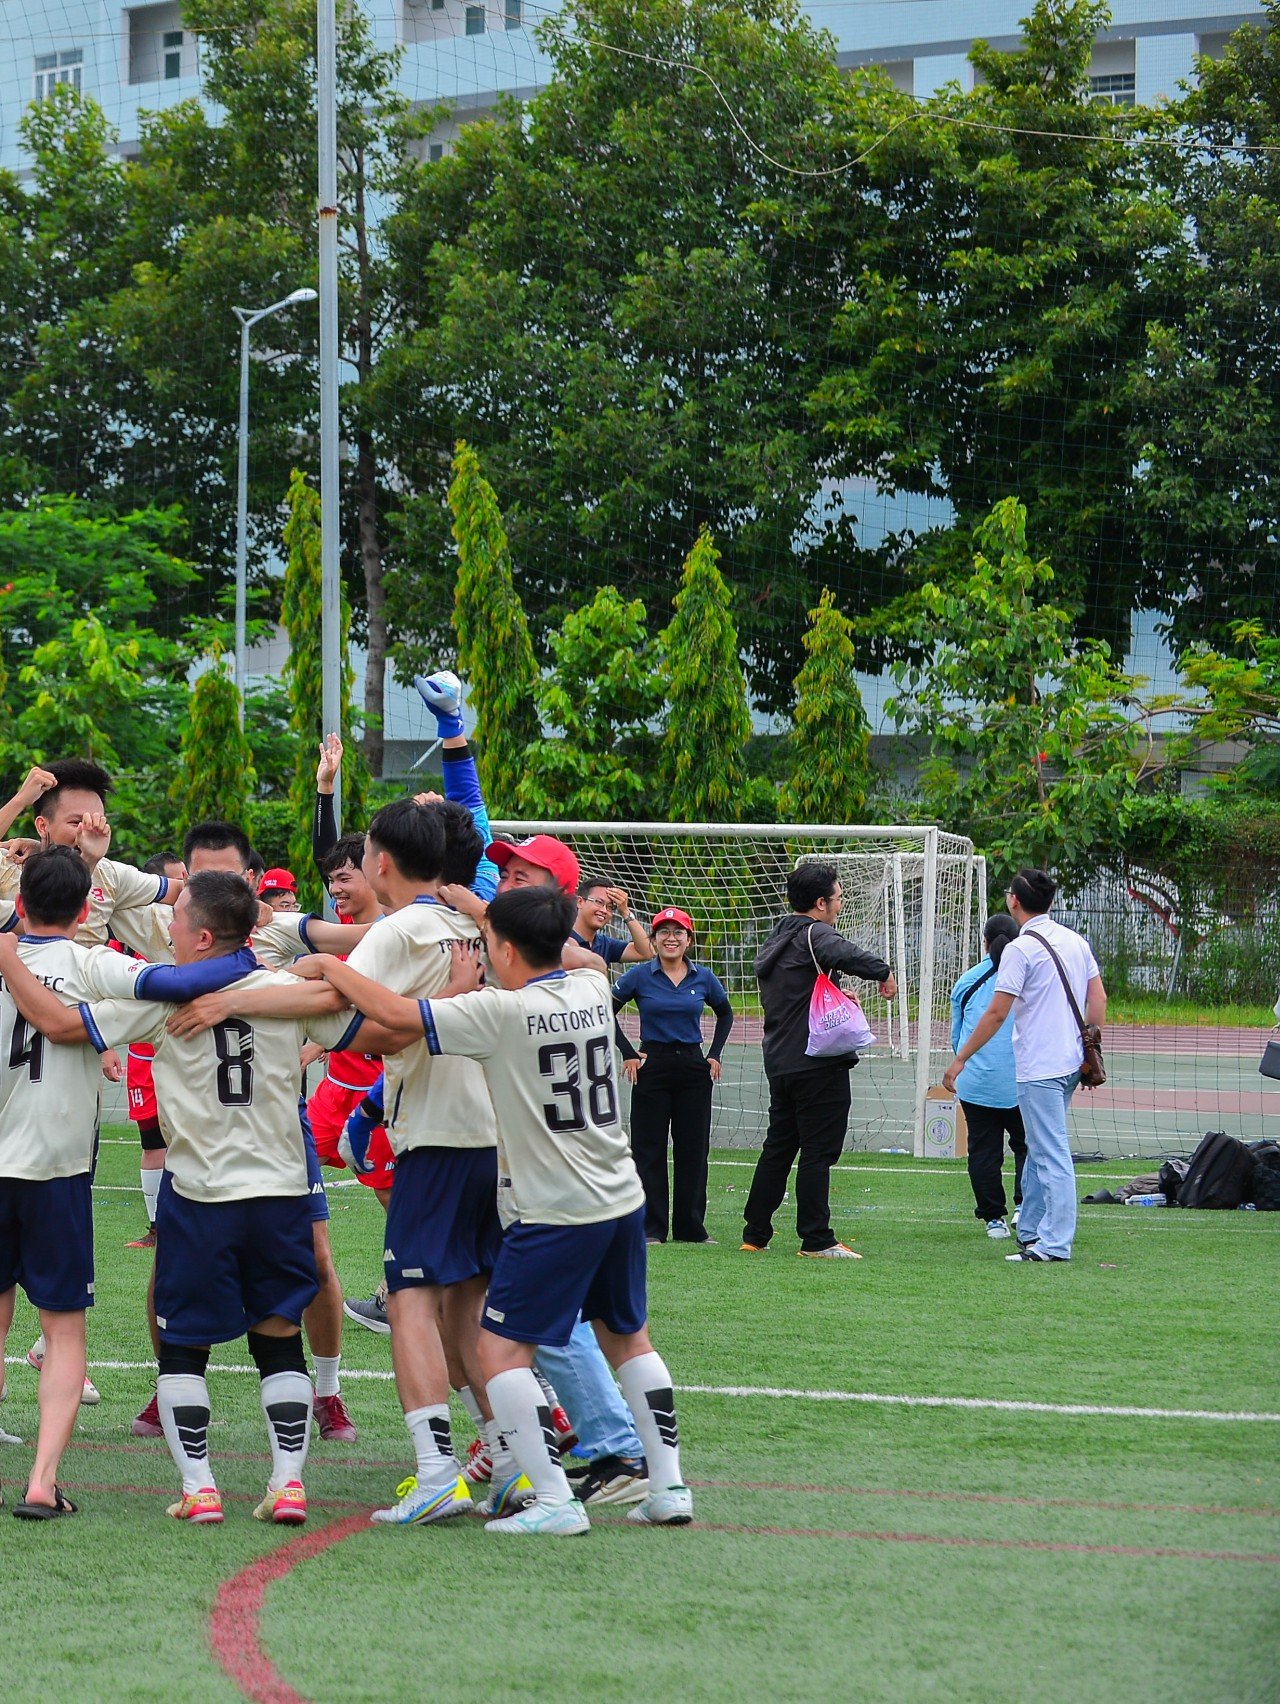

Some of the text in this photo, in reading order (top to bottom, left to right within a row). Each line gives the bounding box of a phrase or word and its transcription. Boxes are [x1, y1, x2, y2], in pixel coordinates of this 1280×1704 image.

[527, 1006, 595, 1036] FACTORY
[212, 1017, 255, 1107] 8
[538, 1035, 618, 1134] 38
[129, 1088, 144, 1108] 14
